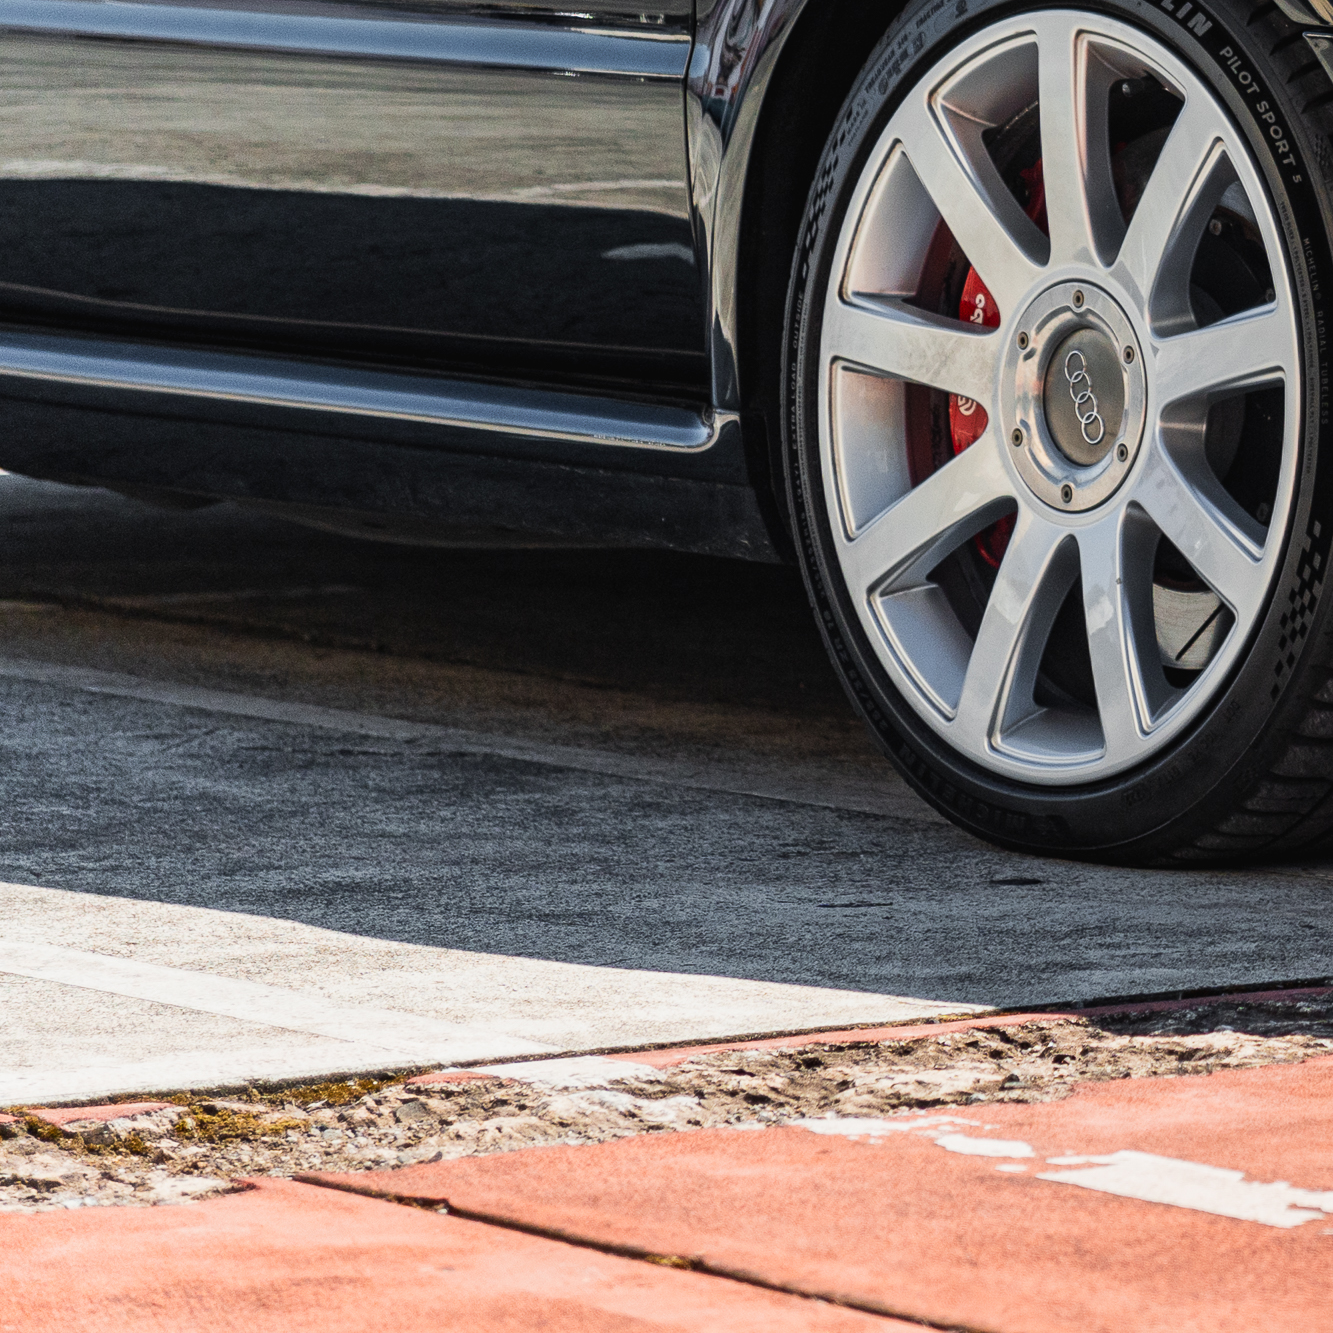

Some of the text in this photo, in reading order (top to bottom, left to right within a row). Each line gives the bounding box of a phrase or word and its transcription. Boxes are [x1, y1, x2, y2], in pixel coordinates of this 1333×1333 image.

[1219, 46, 1260, 94] PILOT
[1256, 100, 1296, 166] SPORT
[1292, 173, 1302, 184] 5
[1302, 237, 1319, 292] MICHELIN
[792, 290, 804, 349] OUTSIDE
[1316, 310, 1327, 354] RADIAL
[1320, 361, 1329, 425] TUBELESS
[896, 740, 1025, 837] MICHELIN
